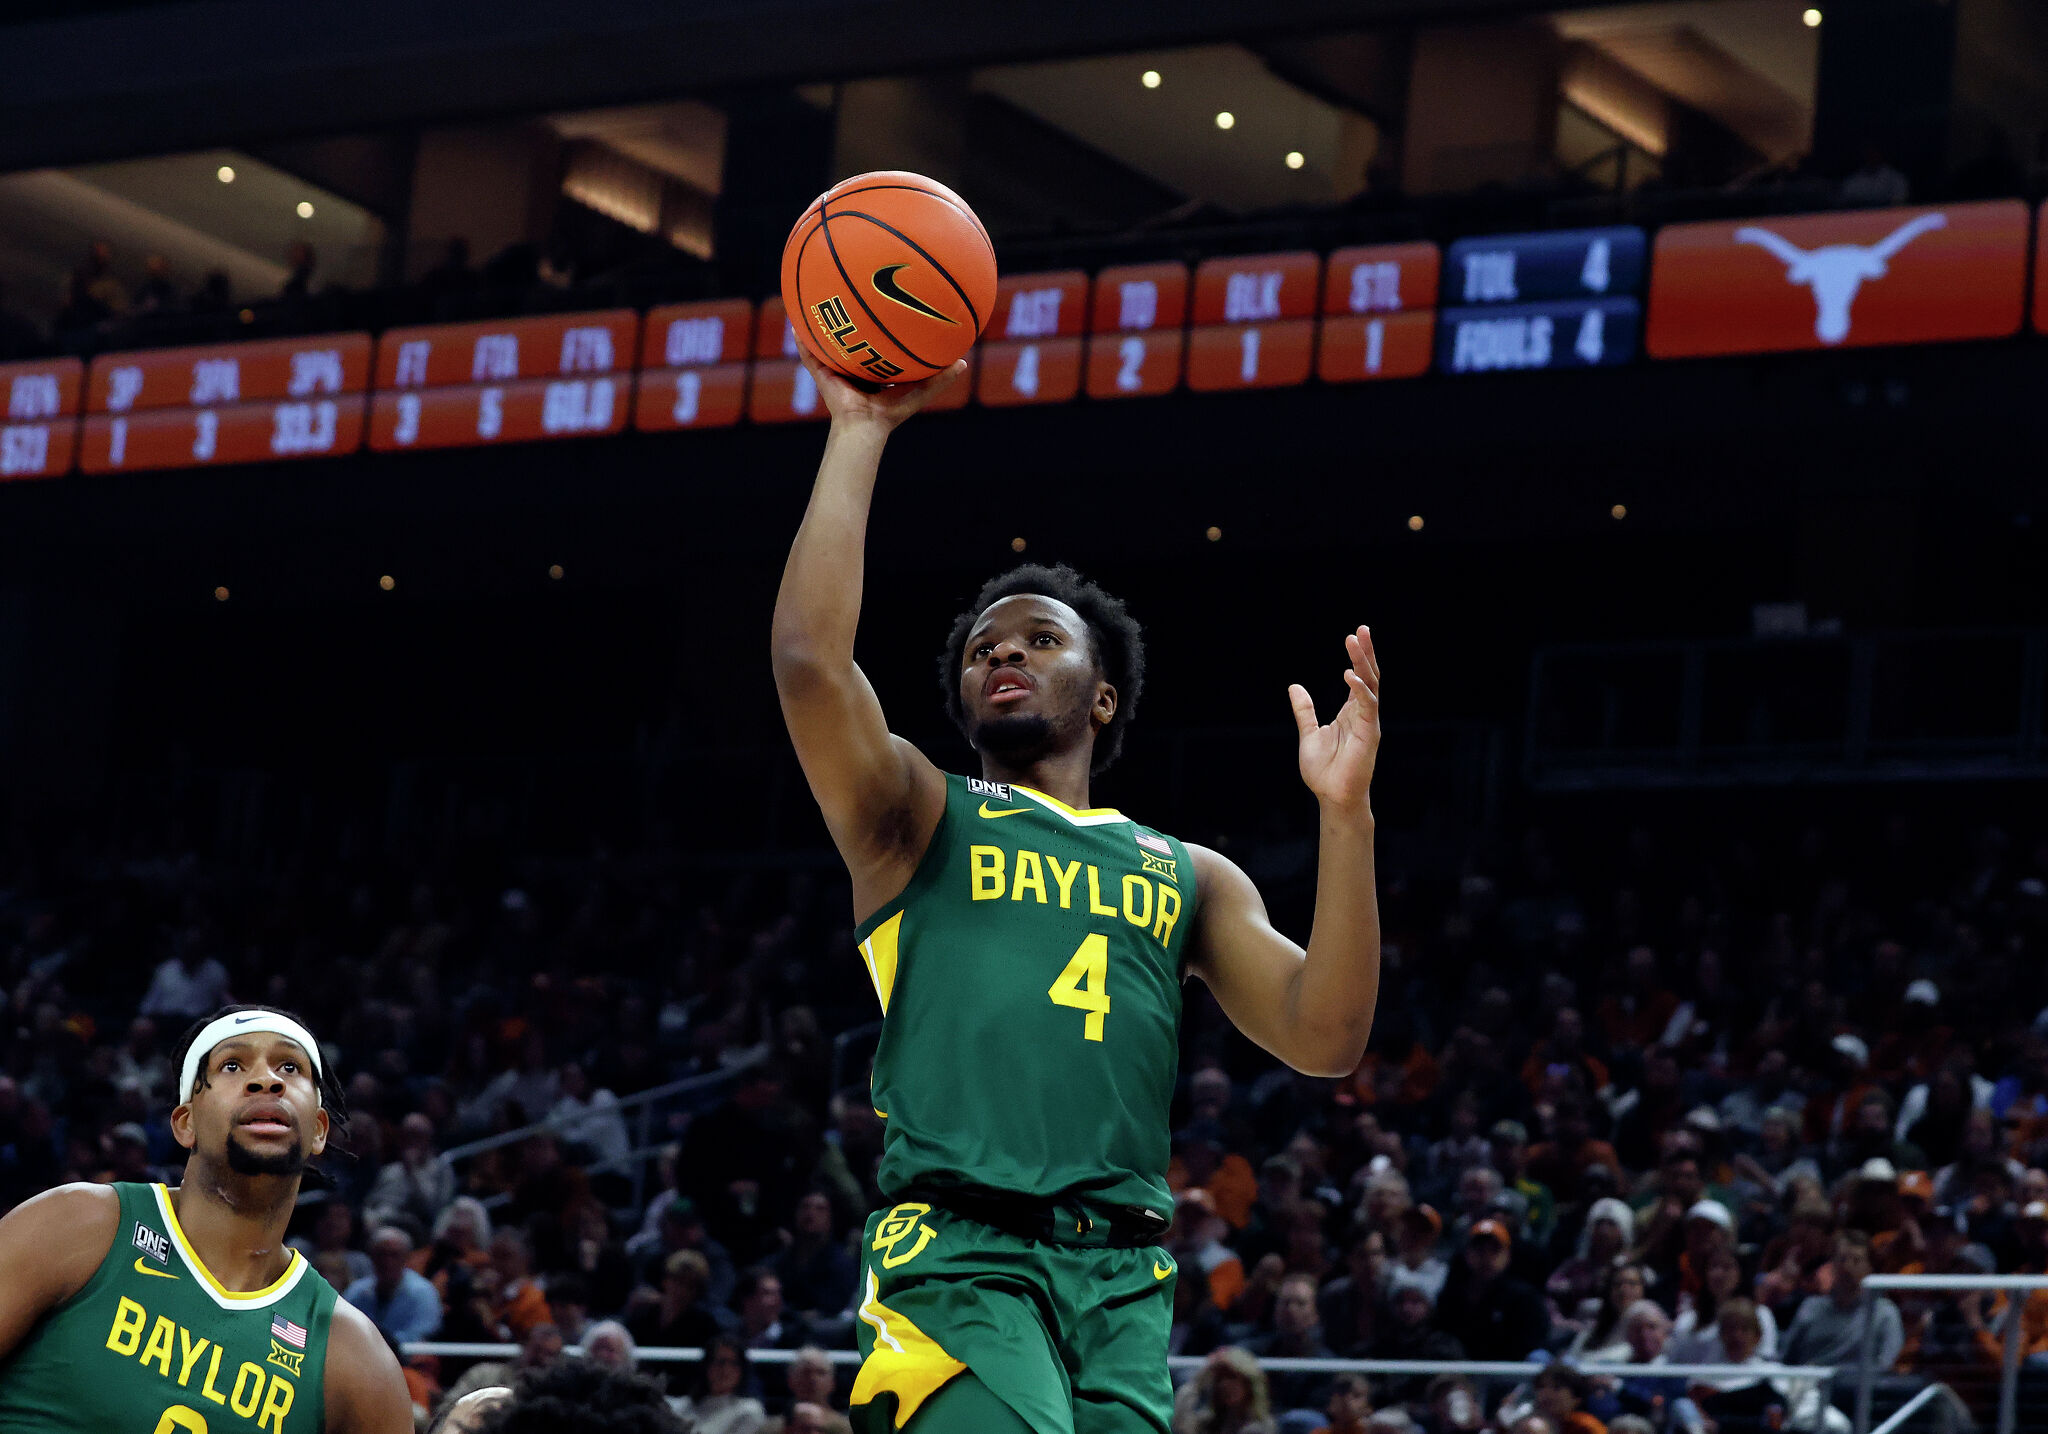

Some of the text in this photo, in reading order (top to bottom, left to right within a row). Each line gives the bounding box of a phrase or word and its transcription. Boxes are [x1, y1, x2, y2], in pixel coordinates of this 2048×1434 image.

[1582, 237, 1611, 290] 4
[816, 295, 905, 379] ELITE
[1117, 337, 1145, 391] 2
[1241, 329, 1261, 382] 1
[1365, 319, 1384, 373] 1
[1454, 308, 1604, 371] FOULS 4
[673, 371, 701, 423] 3
[1013, 345, 1040, 397] 4
[110, 417, 128, 466] 1
[193, 410, 219, 460] 3
[395, 394, 422, 444] 3
[477, 387, 504, 438] 5
[970, 778, 1009, 799] ONE
[970, 845, 1182, 949] BAYLOR
[1047, 932, 1111, 1042] 4
[136, 1225, 169, 1261] ONE
[105, 1295, 295, 1434] BAYLOR
